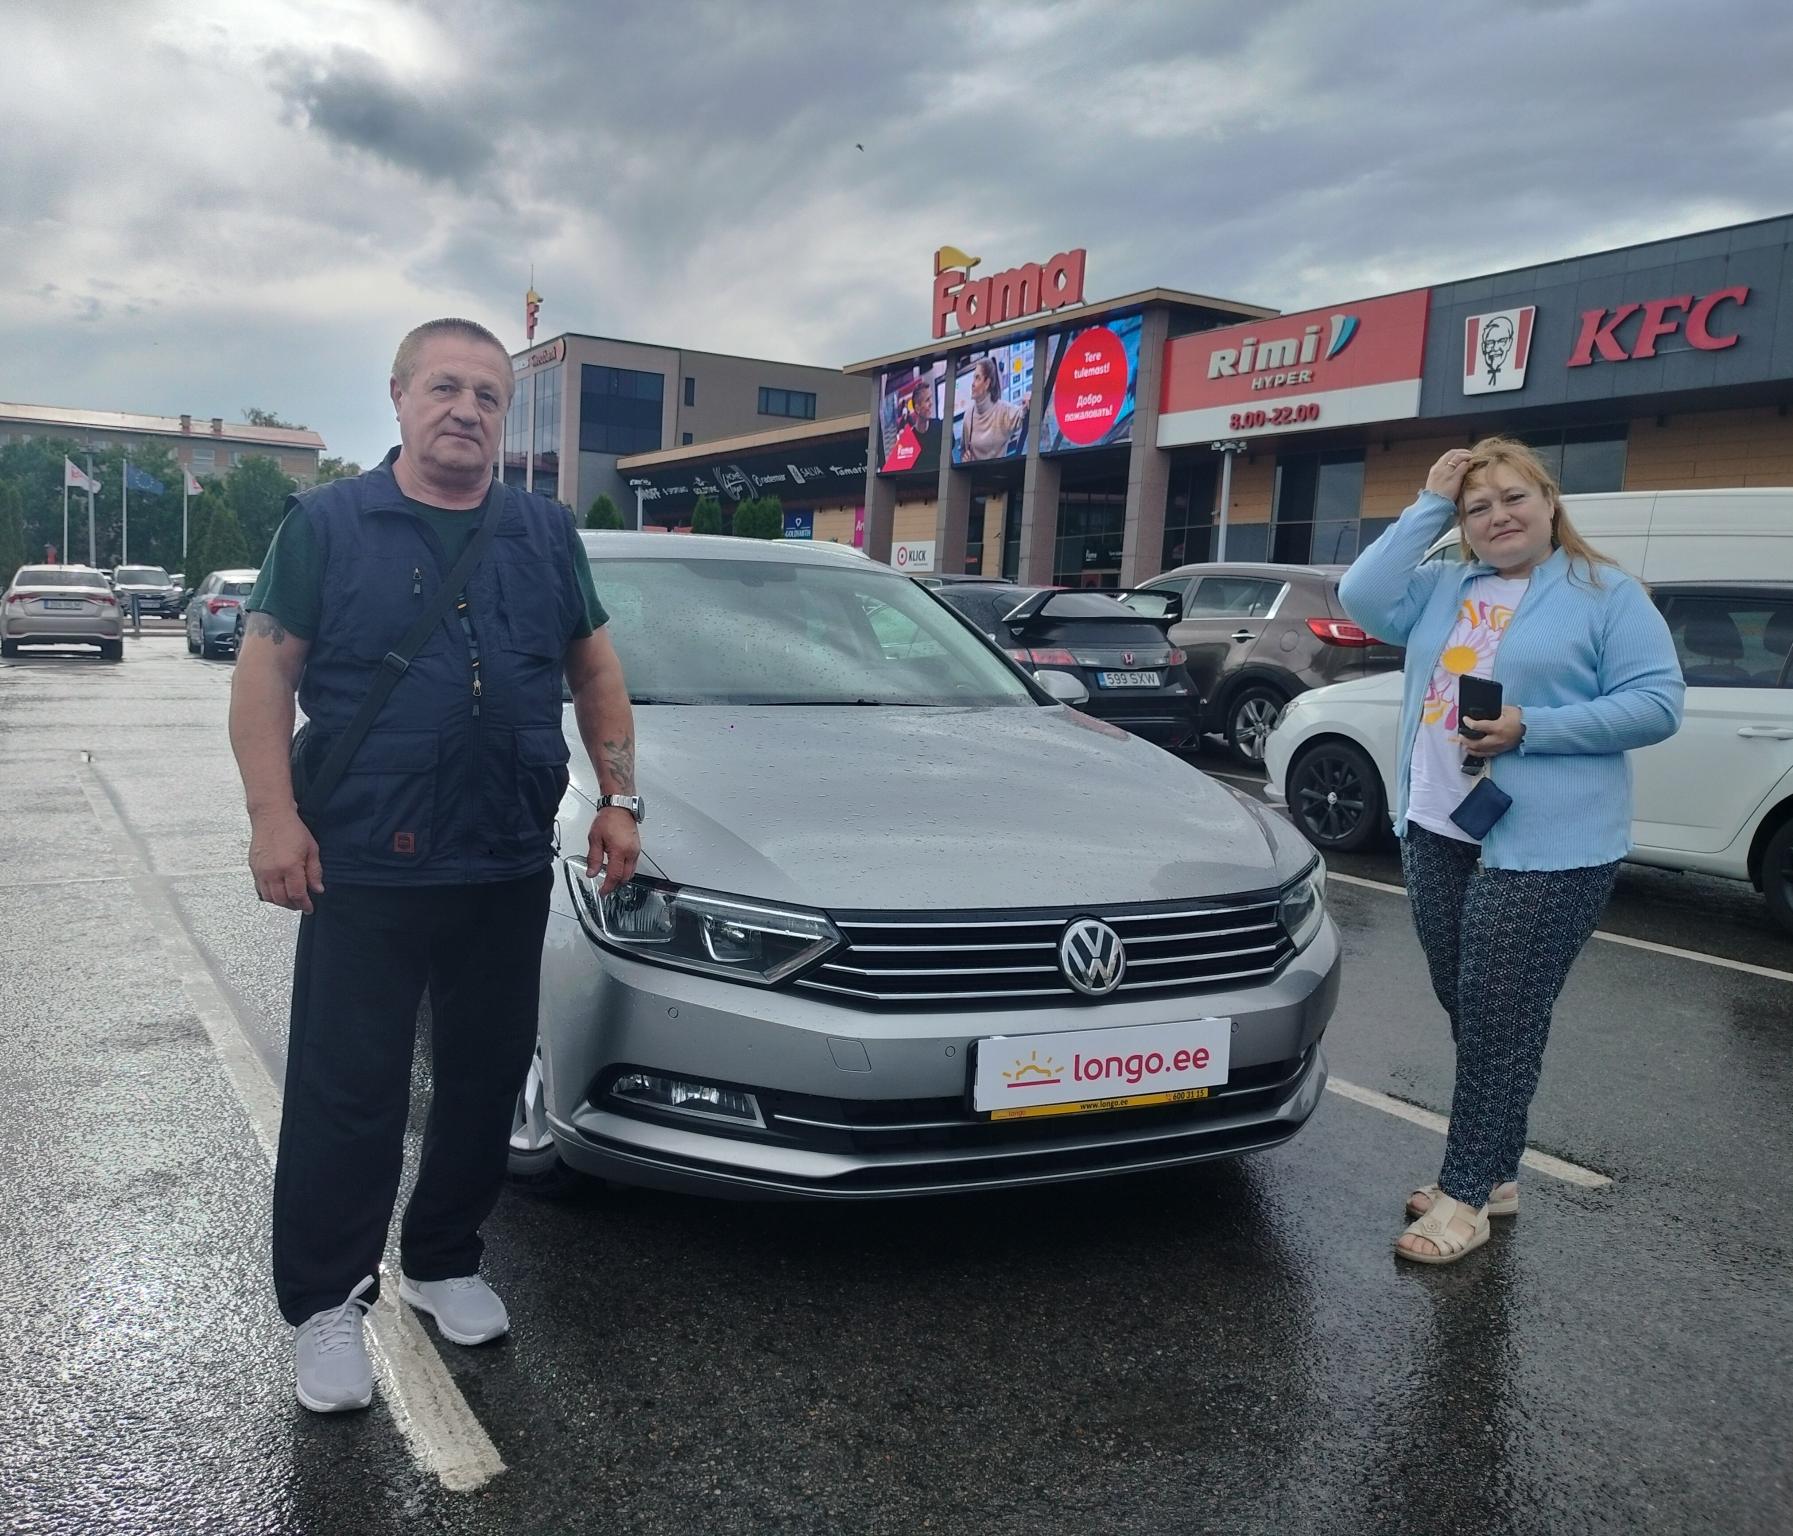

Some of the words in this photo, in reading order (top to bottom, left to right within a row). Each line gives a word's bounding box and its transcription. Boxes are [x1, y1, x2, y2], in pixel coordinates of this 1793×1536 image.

[932, 249, 1087, 339] Fama
[1567, 286, 1749, 367] KFC
[1084, 351, 1102, 363] Tere
[1207, 325, 1321, 379] Rimi
[1073, 362, 1111, 379] tulemast!
[1252, 369, 1313, 389] HYPER
[1076, 393, 1102, 409] Добро
[1064, 404, 1113, 422] пожаловать!
[1229, 403, 1320, 430] 8.00-22.00
[800, 466, 823, 478] SALVA
[830, 463, 868, 476] Tamari
[908, 550, 927, 561] KLICK
[1106, 673, 1129, 685] 599
[1130, 673, 1156, 685] SXW
[1073, 1047, 1210, 1084] longo.ee
[1079, 1099, 1129, 1110] www.longo.ee
[1172, 1091, 1186, 1101] 600
[1186, 1090, 1195, 1099] 31
[1196, 1089, 1205, 1097] 15
